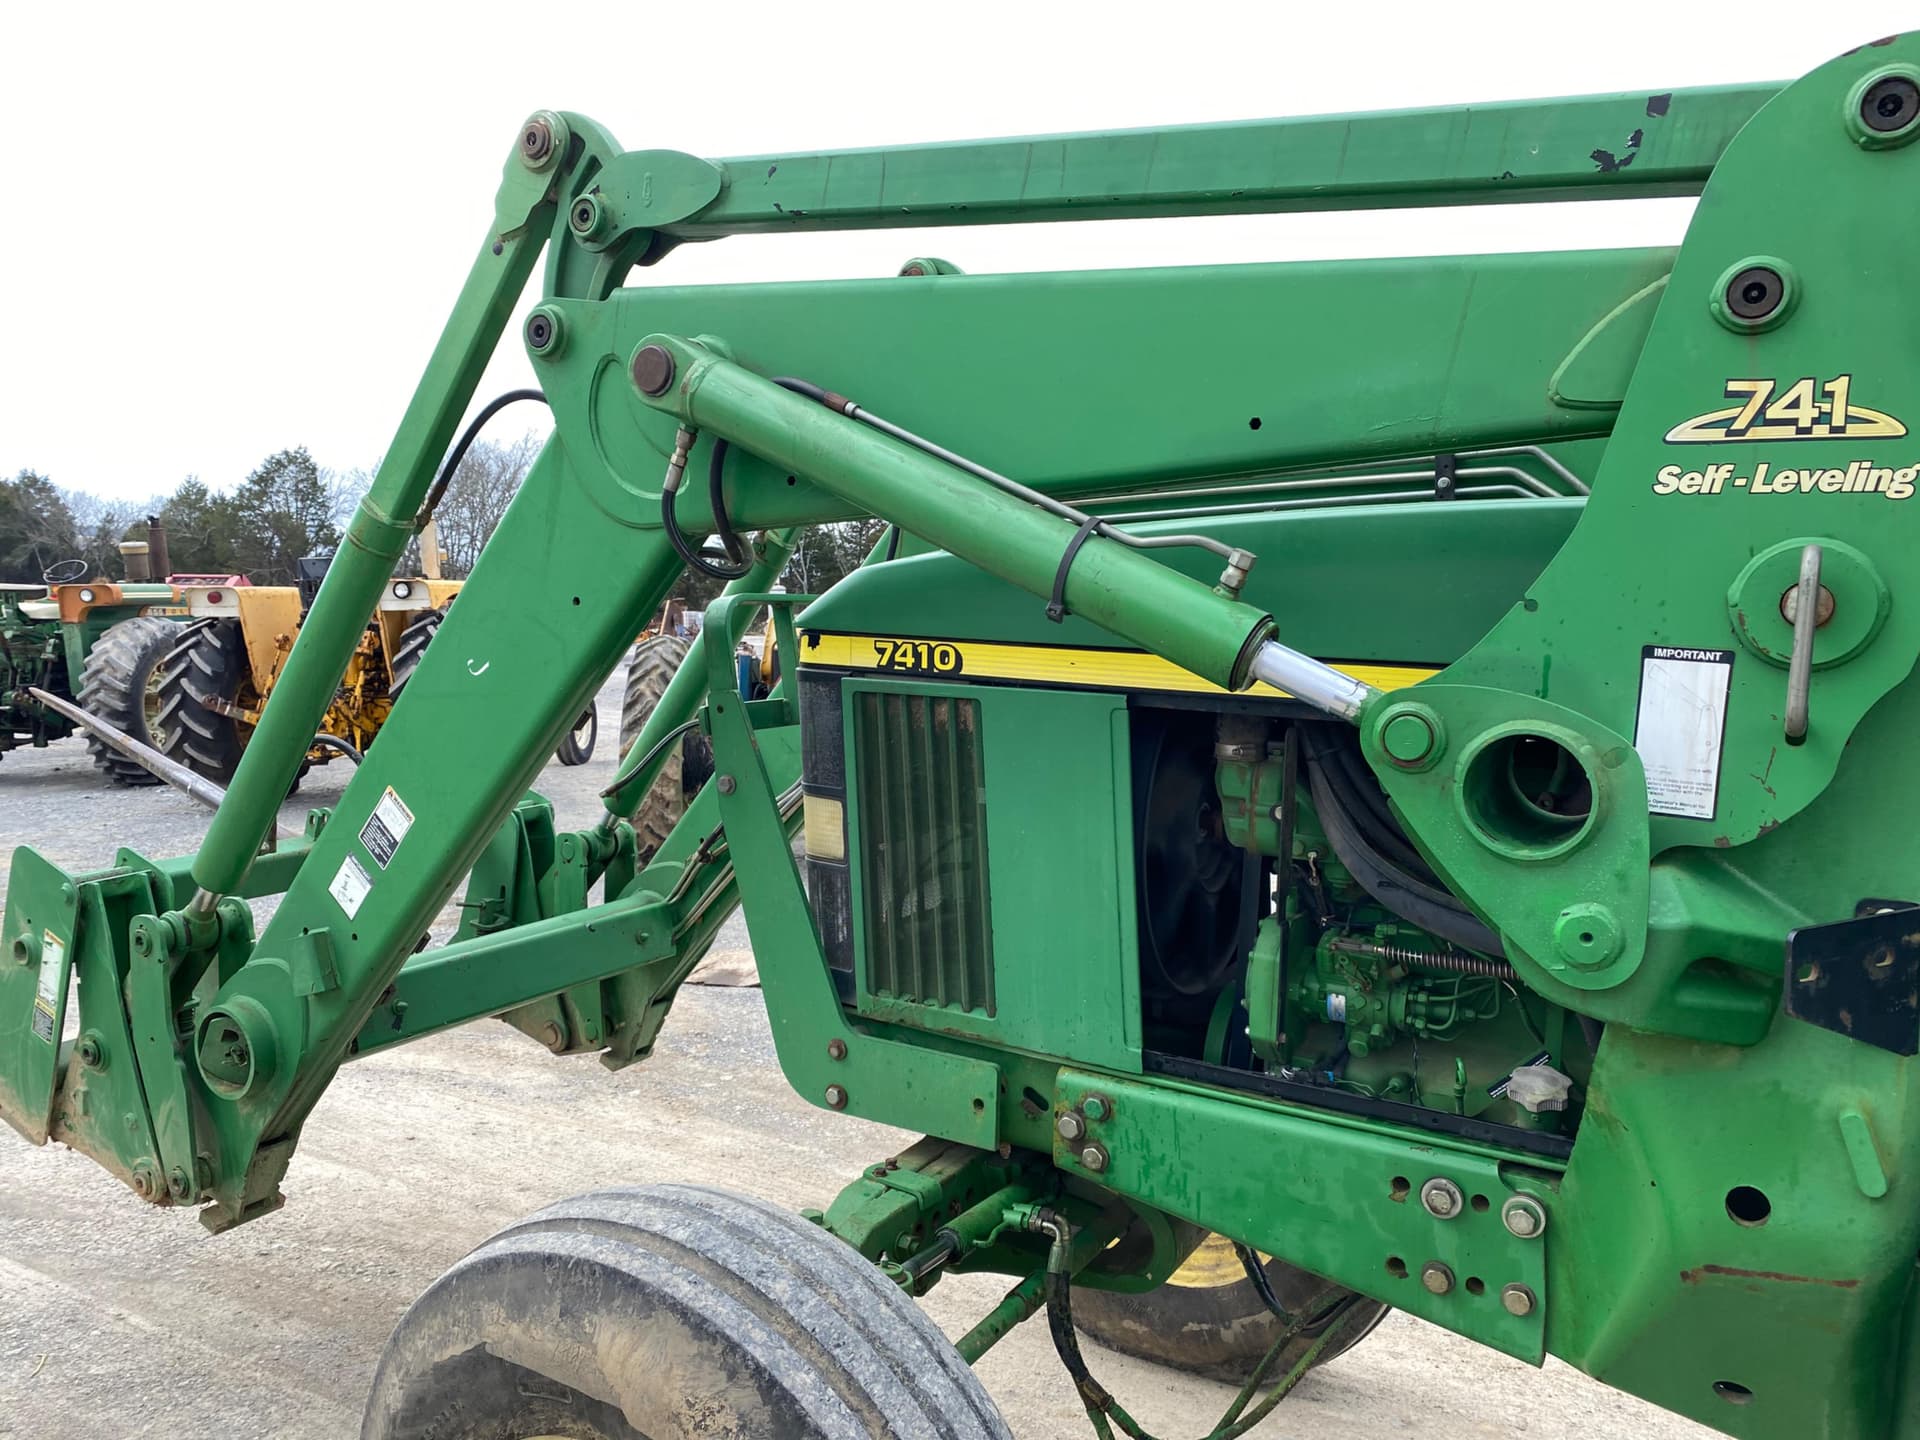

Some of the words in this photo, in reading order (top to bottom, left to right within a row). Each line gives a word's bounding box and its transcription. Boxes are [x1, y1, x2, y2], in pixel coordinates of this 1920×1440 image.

[1724, 374, 1851, 437] 741
[874, 640, 962, 672] 7410
[1653, 647, 1723, 662] IMPORTANT
